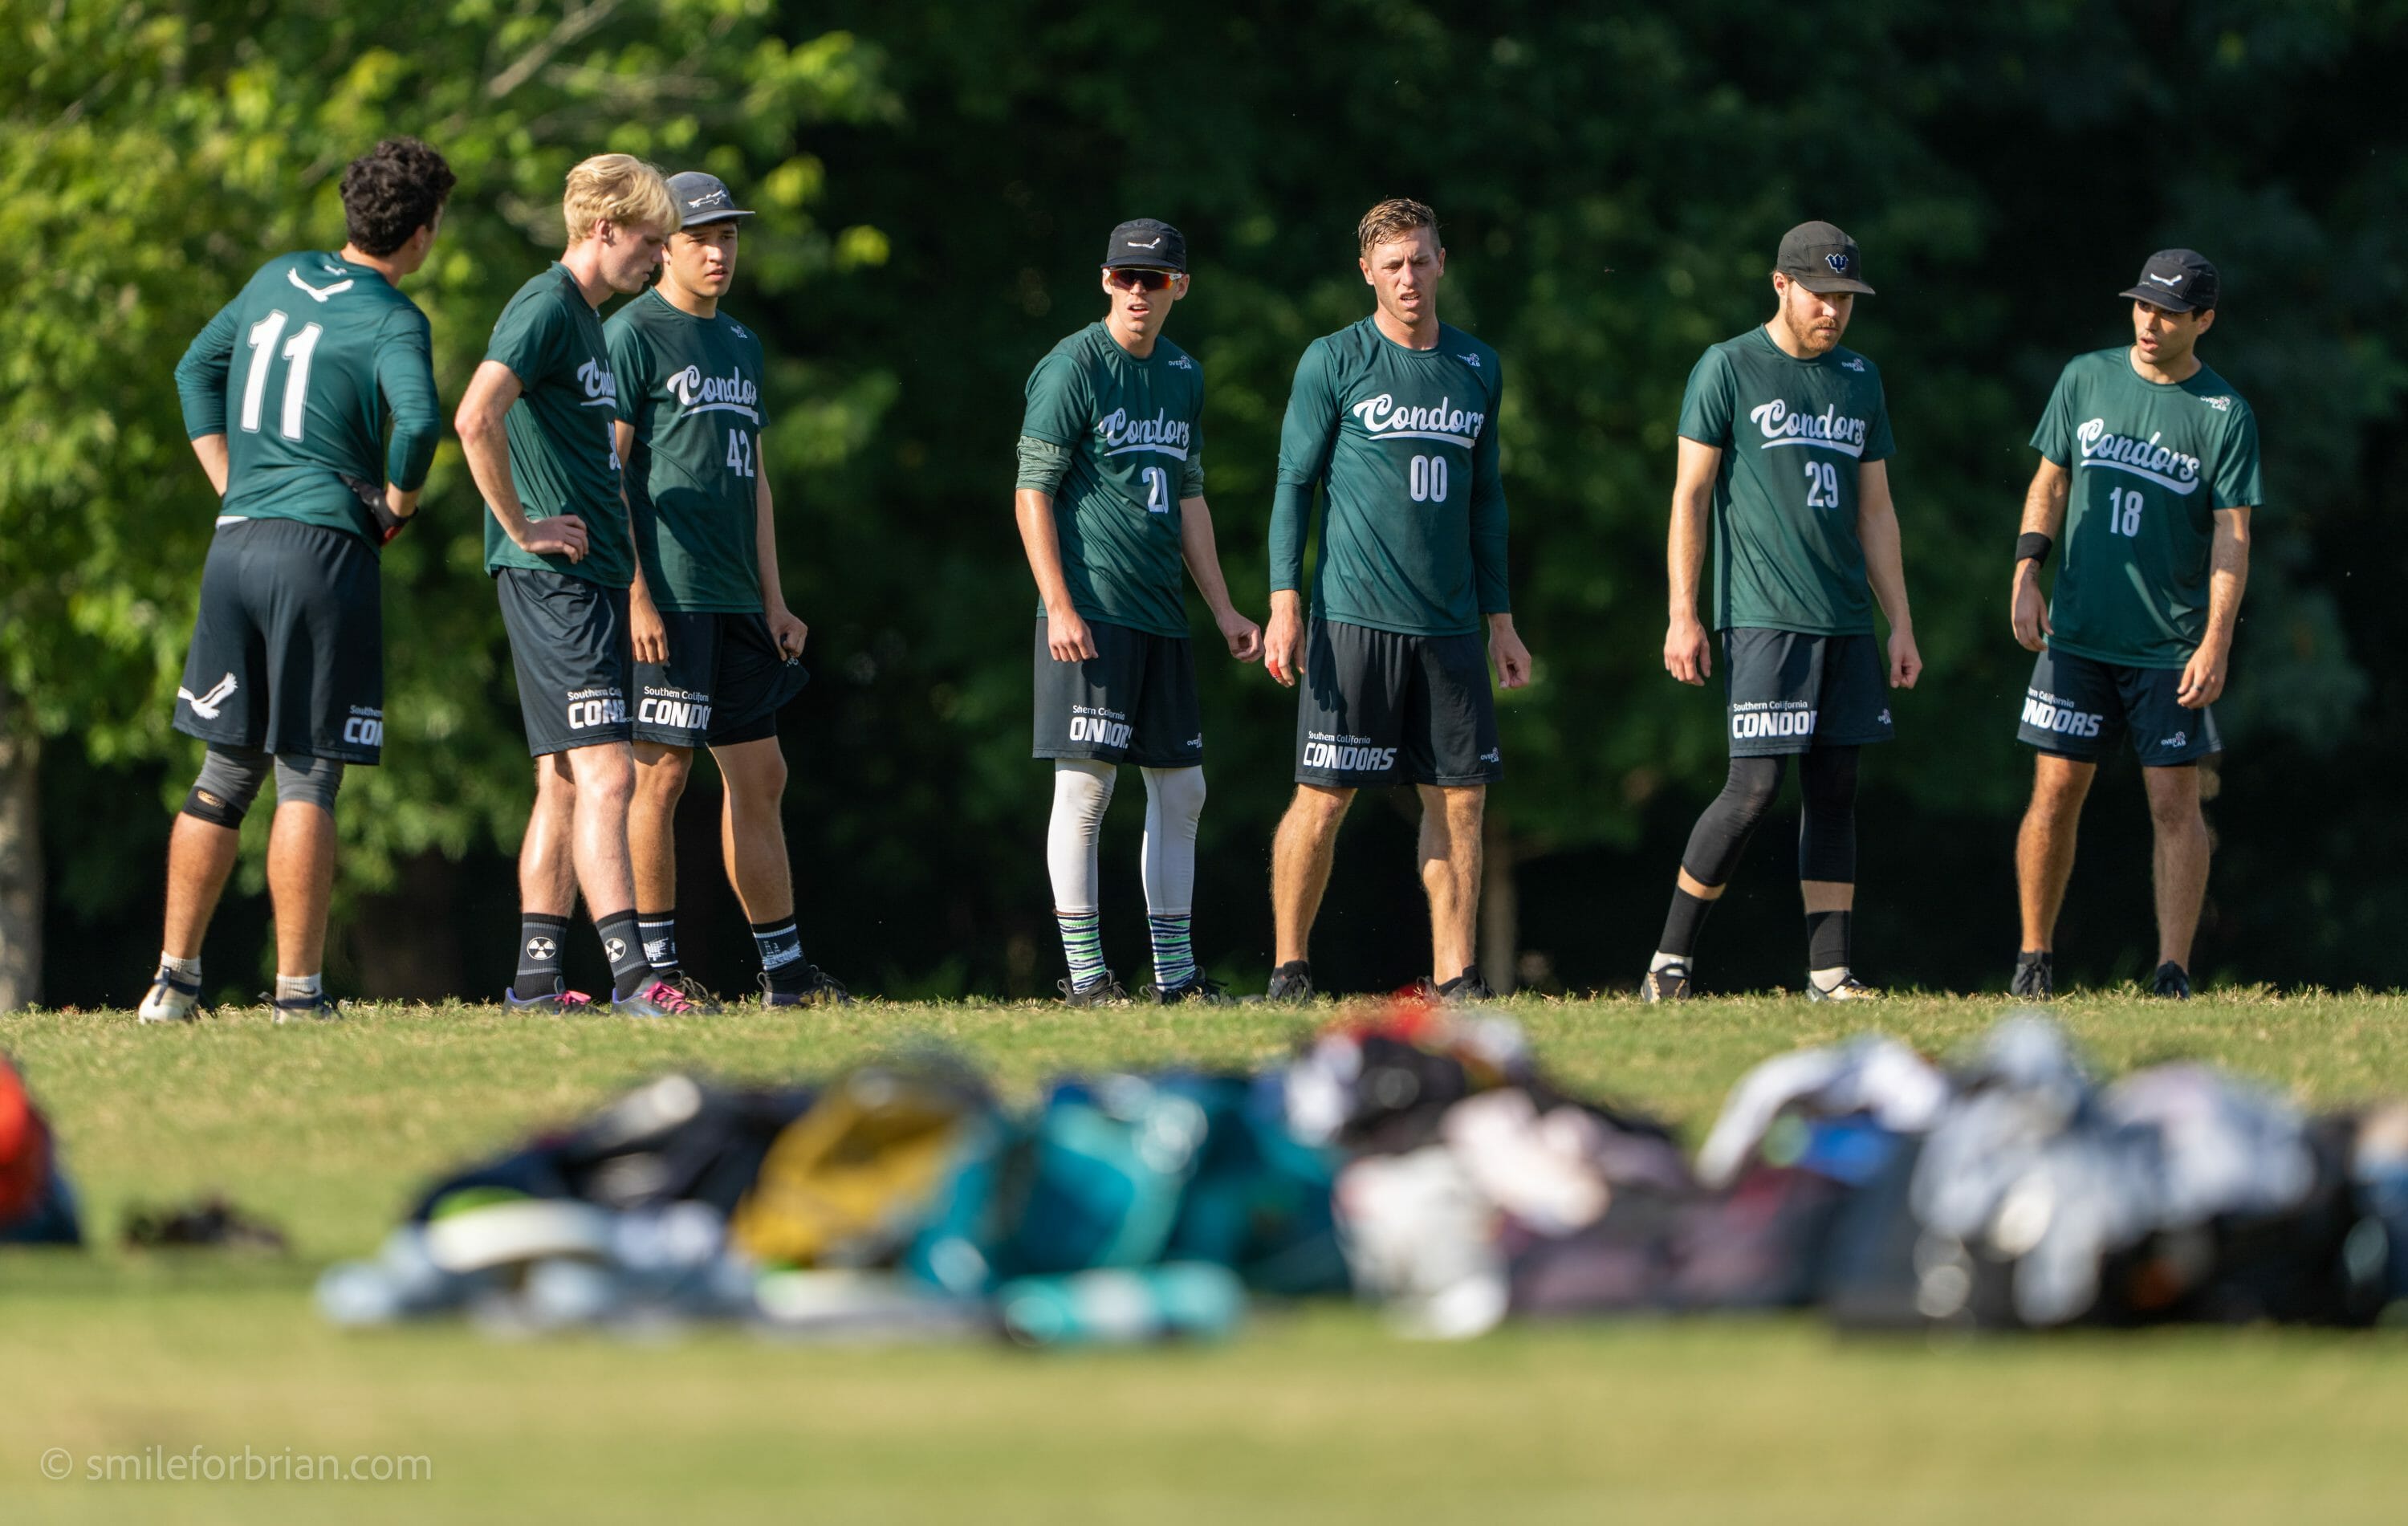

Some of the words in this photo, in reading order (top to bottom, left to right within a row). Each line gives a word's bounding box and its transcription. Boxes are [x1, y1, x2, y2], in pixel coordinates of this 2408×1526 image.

[242, 309, 323, 442] 11
[1352, 393, 1484, 438] Condors
[1751, 398, 1865, 443] Condors
[726, 429, 755, 478] 42
[2077, 418, 2200, 482] Condors
[1410, 454, 1447, 503] 00
[1805, 461, 1839, 508] 29
[2109, 486, 2144, 538] 18
[567, 688, 608, 701] Southern
[644, 686, 680, 699] Southern
[1734, 701, 1767, 712] Southern
[1769, 700, 1808, 711] California
[638, 698, 712, 730] CONDO
[1732, 710, 1817, 739] CONDO
[2021, 697, 2103, 737] NDORS
[1303, 742, 1397, 771] CONDORS
[1336, 734, 1370, 745] California
